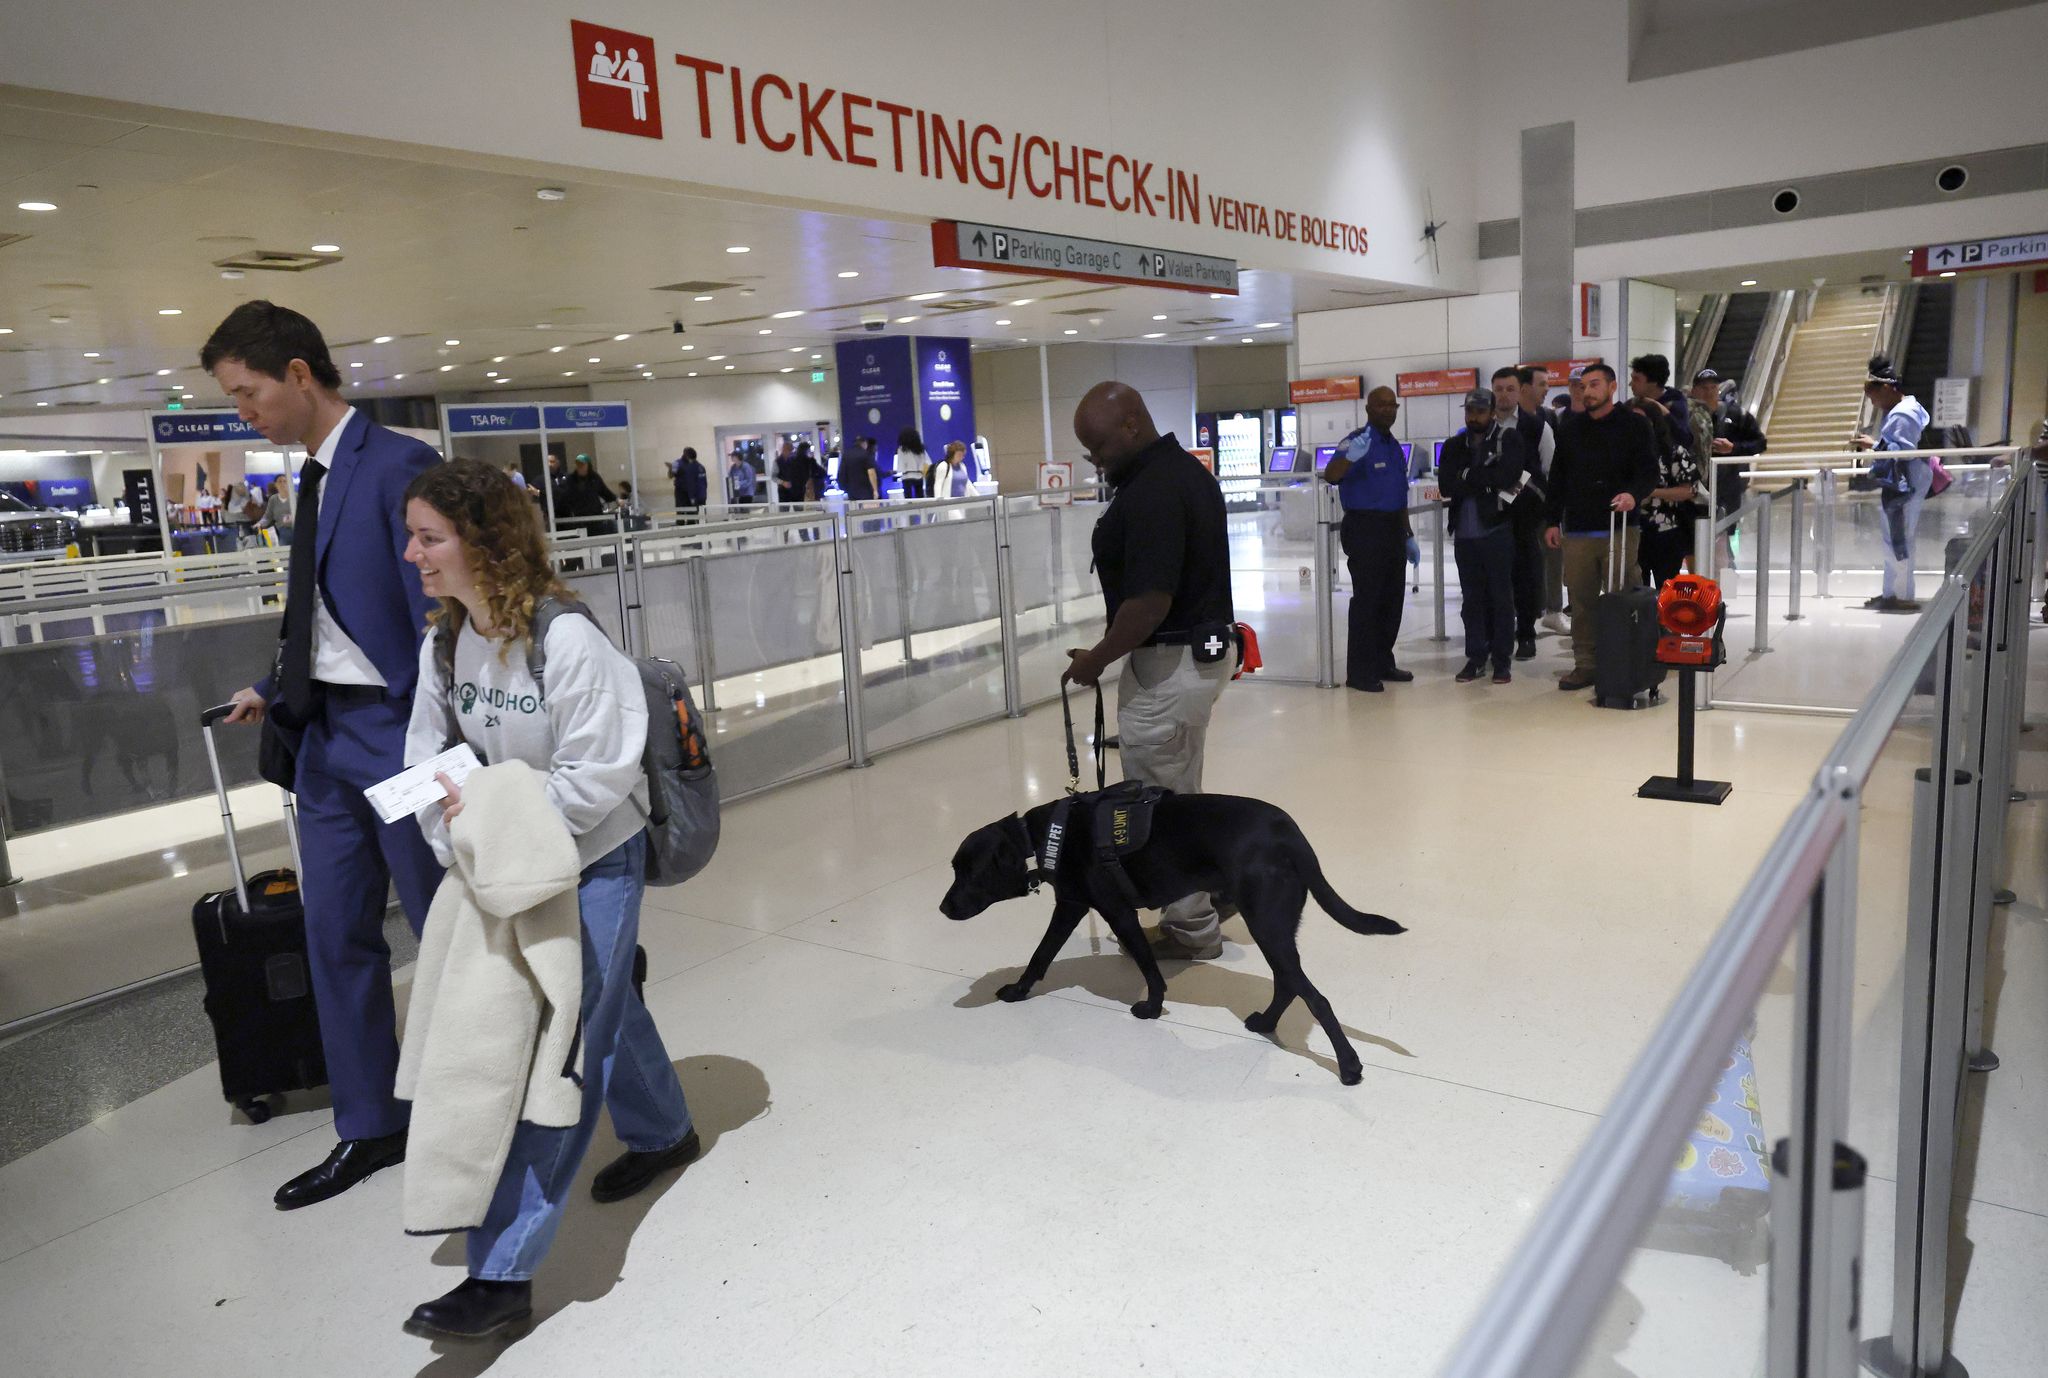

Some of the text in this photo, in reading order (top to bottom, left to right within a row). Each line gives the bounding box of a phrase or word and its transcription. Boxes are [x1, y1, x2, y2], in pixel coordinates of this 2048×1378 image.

[676, 53, 1369, 256] TICKETING/CHECK-IN VENTA DE BOLETOS
[1012, 239, 1061, 267] Parking
[1066, 246, 1110, 272] Garage
[1113, 252, 1121, 270] C
[1167, 259, 1193, 277] Valet
[1196, 263, 1231, 286] Parking
[177, 423, 210, 432] CLEAR
[228, 422, 247, 433] TSA
[471, 415, 489, 426] TSA
[1113, 810, 1127, 829] UNIT
[1043, 823, 1063, 870] DO NOT PET
